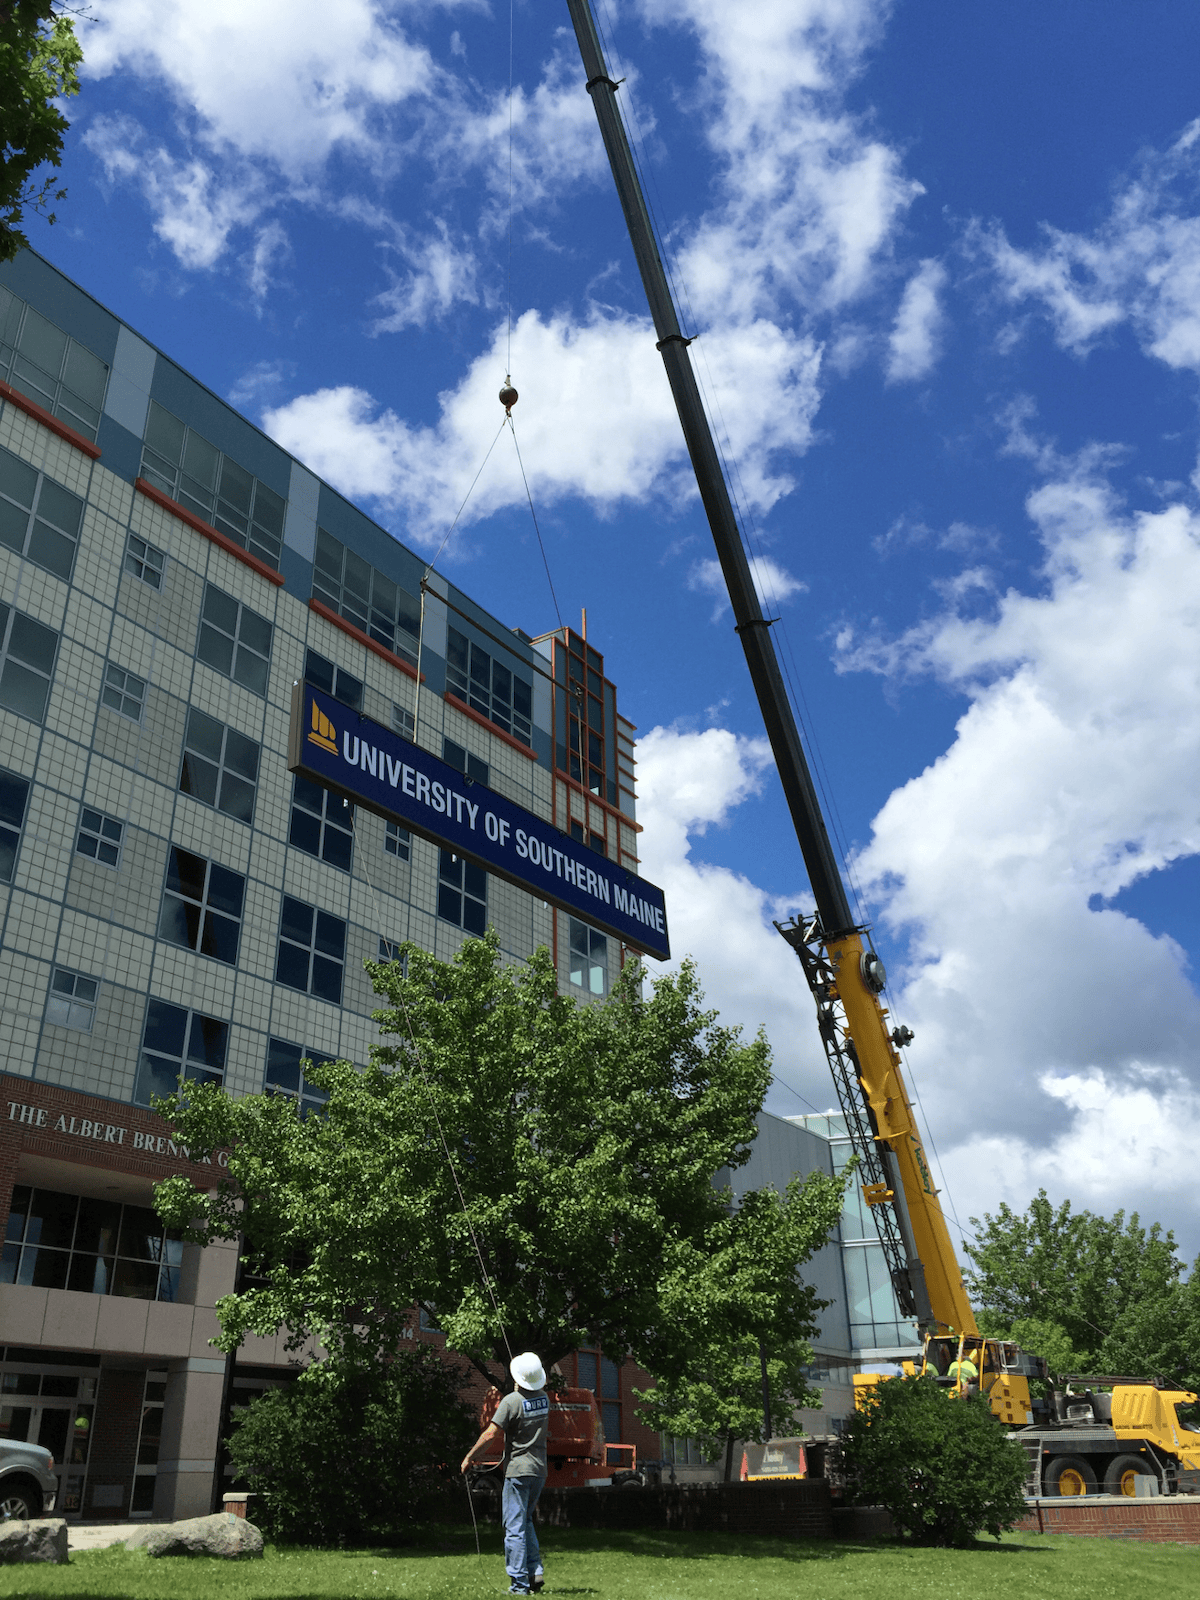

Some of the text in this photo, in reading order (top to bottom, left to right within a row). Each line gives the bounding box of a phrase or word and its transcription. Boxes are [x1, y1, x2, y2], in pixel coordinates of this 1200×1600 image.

[343, 730, 665, 934] UNIVERSITY OF SOUTHERN MAINE
[8, 1102, 48, 1127] THE
[54, 1114, 127, 1144] ALBERT
[133, 1132, 211, 1165] BRENNR
[525, 1398, 547, 1411] BURR
